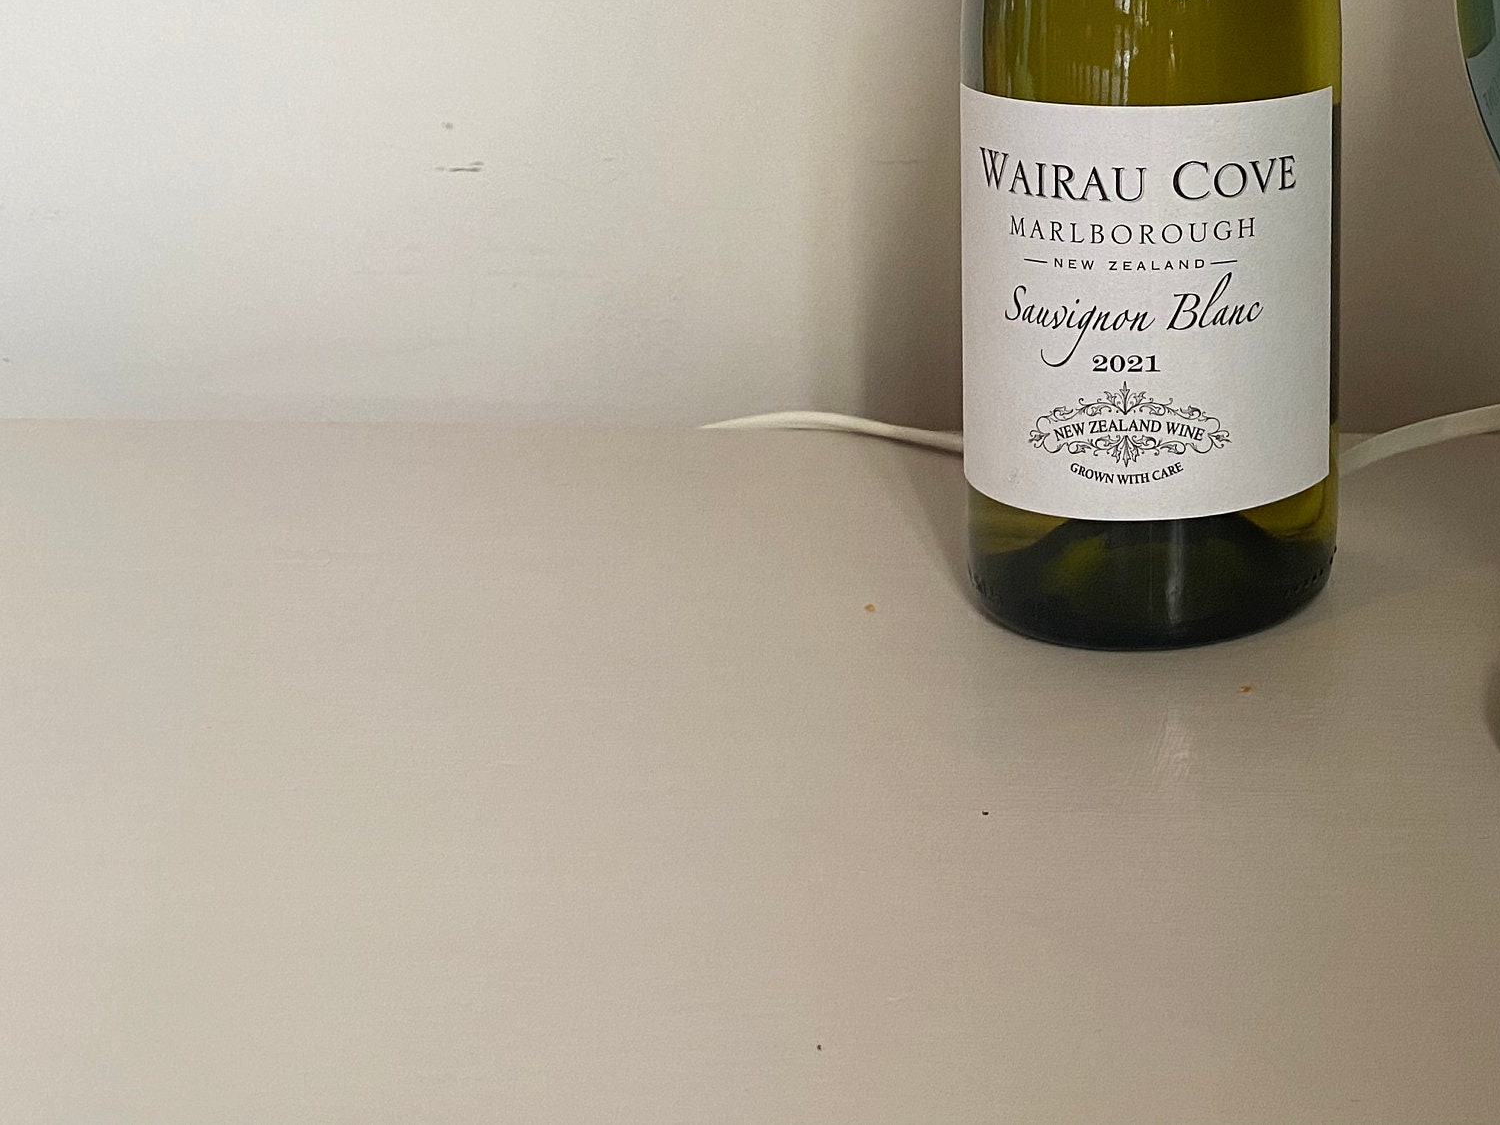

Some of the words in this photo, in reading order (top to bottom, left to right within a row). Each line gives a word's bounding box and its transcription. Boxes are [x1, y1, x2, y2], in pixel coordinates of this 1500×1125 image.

[979, 146, 1147, 202] WAIRAU
[1172, 155, 1297, 201] COVE
[1009, 215, 1256, 246] MARLBOROUGH
[1053, 258, 1095, 271] NEW
[1108, 258, 1206, 272] ZEALAND
[1004, 285, 1156, 368] Sauvignon
[1166, 272, 1264, 331] Blanc
[1092, 354, 1161, 373] 2021
[1053, 421, 1086, 442] NEW
[1089, 418, 1163, 435] ZEALAND
[1165, 421, 1206, 442] WINE
[1069, 462, 1115, 485] GROWN
[1116, 473, 1151, 485] WITH
[1152, 461, 1185, 482] CARE
